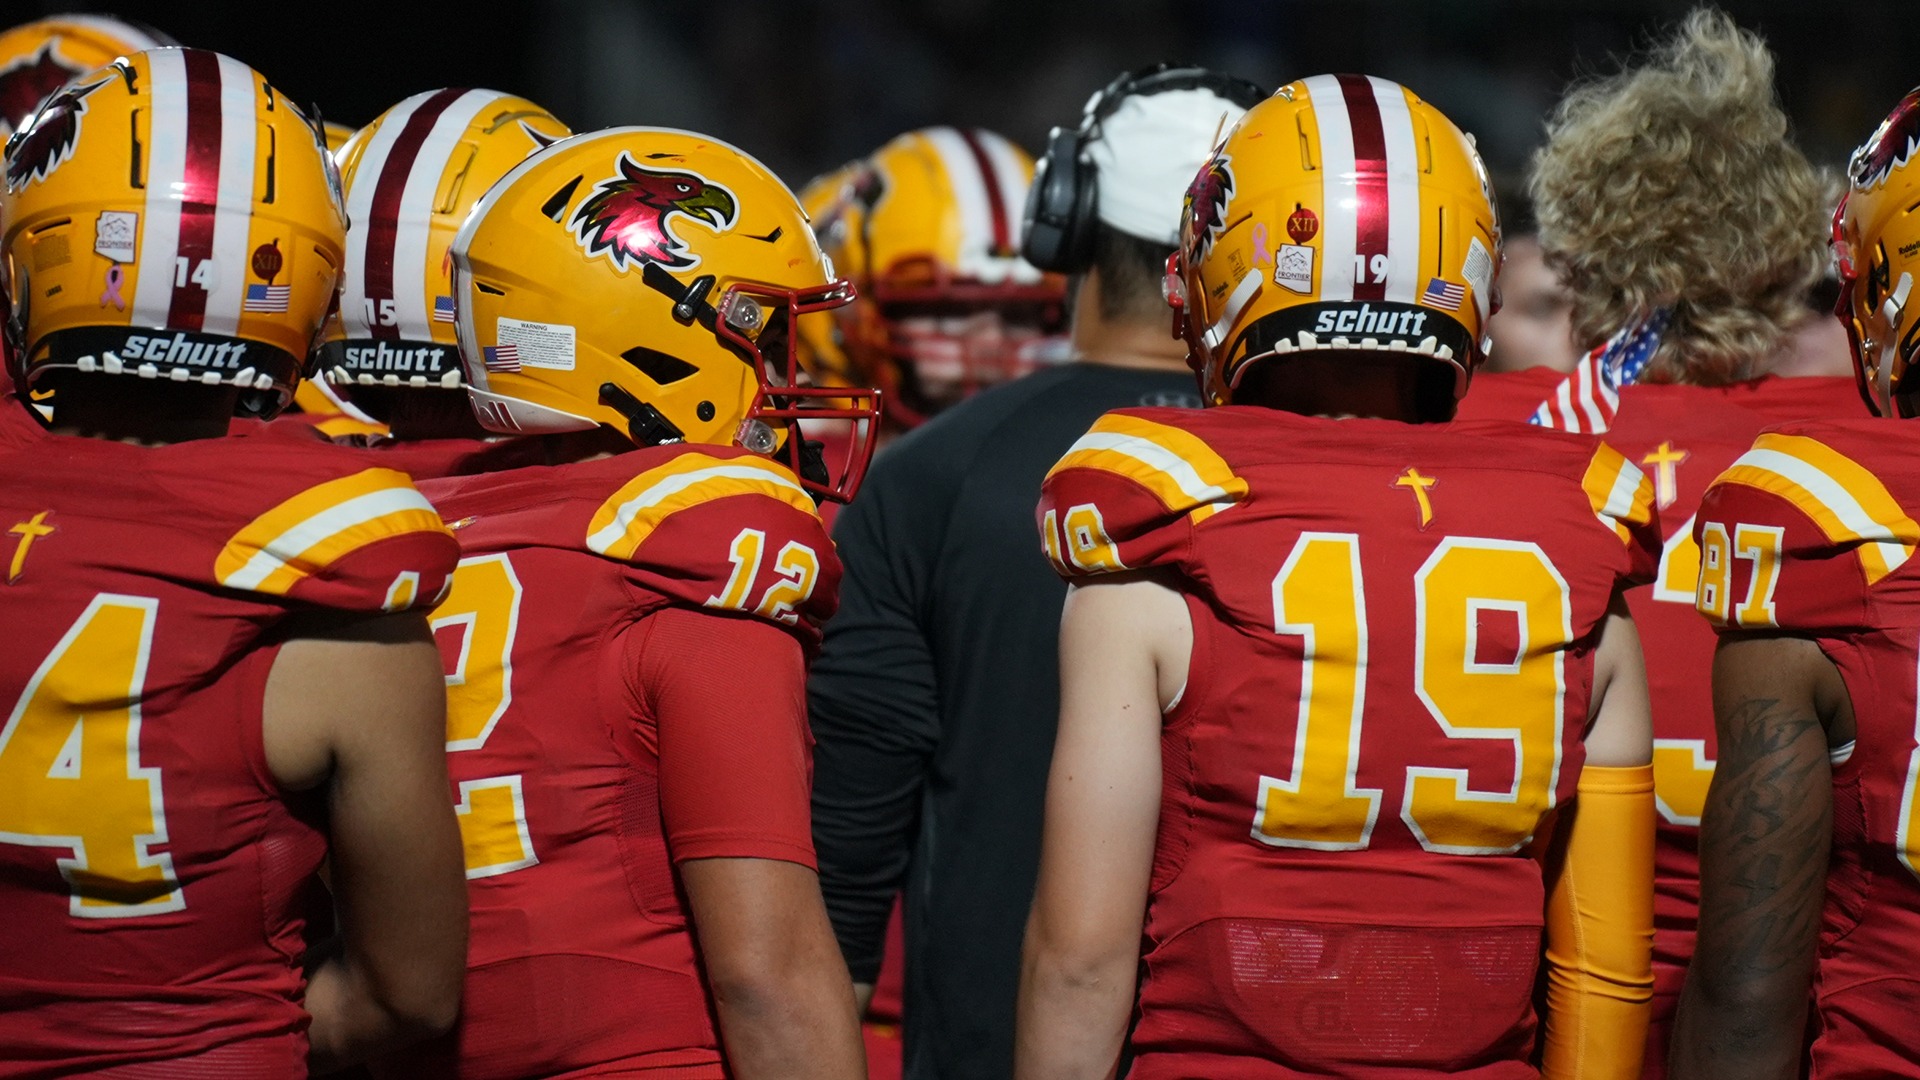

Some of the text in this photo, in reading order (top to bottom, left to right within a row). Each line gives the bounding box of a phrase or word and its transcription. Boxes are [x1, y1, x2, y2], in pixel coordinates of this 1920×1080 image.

[1290, 217, 1316, 233] XII
[175, 256, 214, 290] 14
[256, 254, 279, 271] XII
[1277, 271, 1311, 280] FRONTIER
[1354, 254, 1390, 284] 19
[364, 299, 398, 326] 15
[521, 322, 548, 331] WARNING
[1315, 303, 1427, 336] schutt
[121, 333, 247, 369] schutt
[345, 341, 445, 372] schutt
[701, 527, 820, 626] 12
[1695, 521, 1785, 629] 87
[1250, 531, 1574, 855] 19
